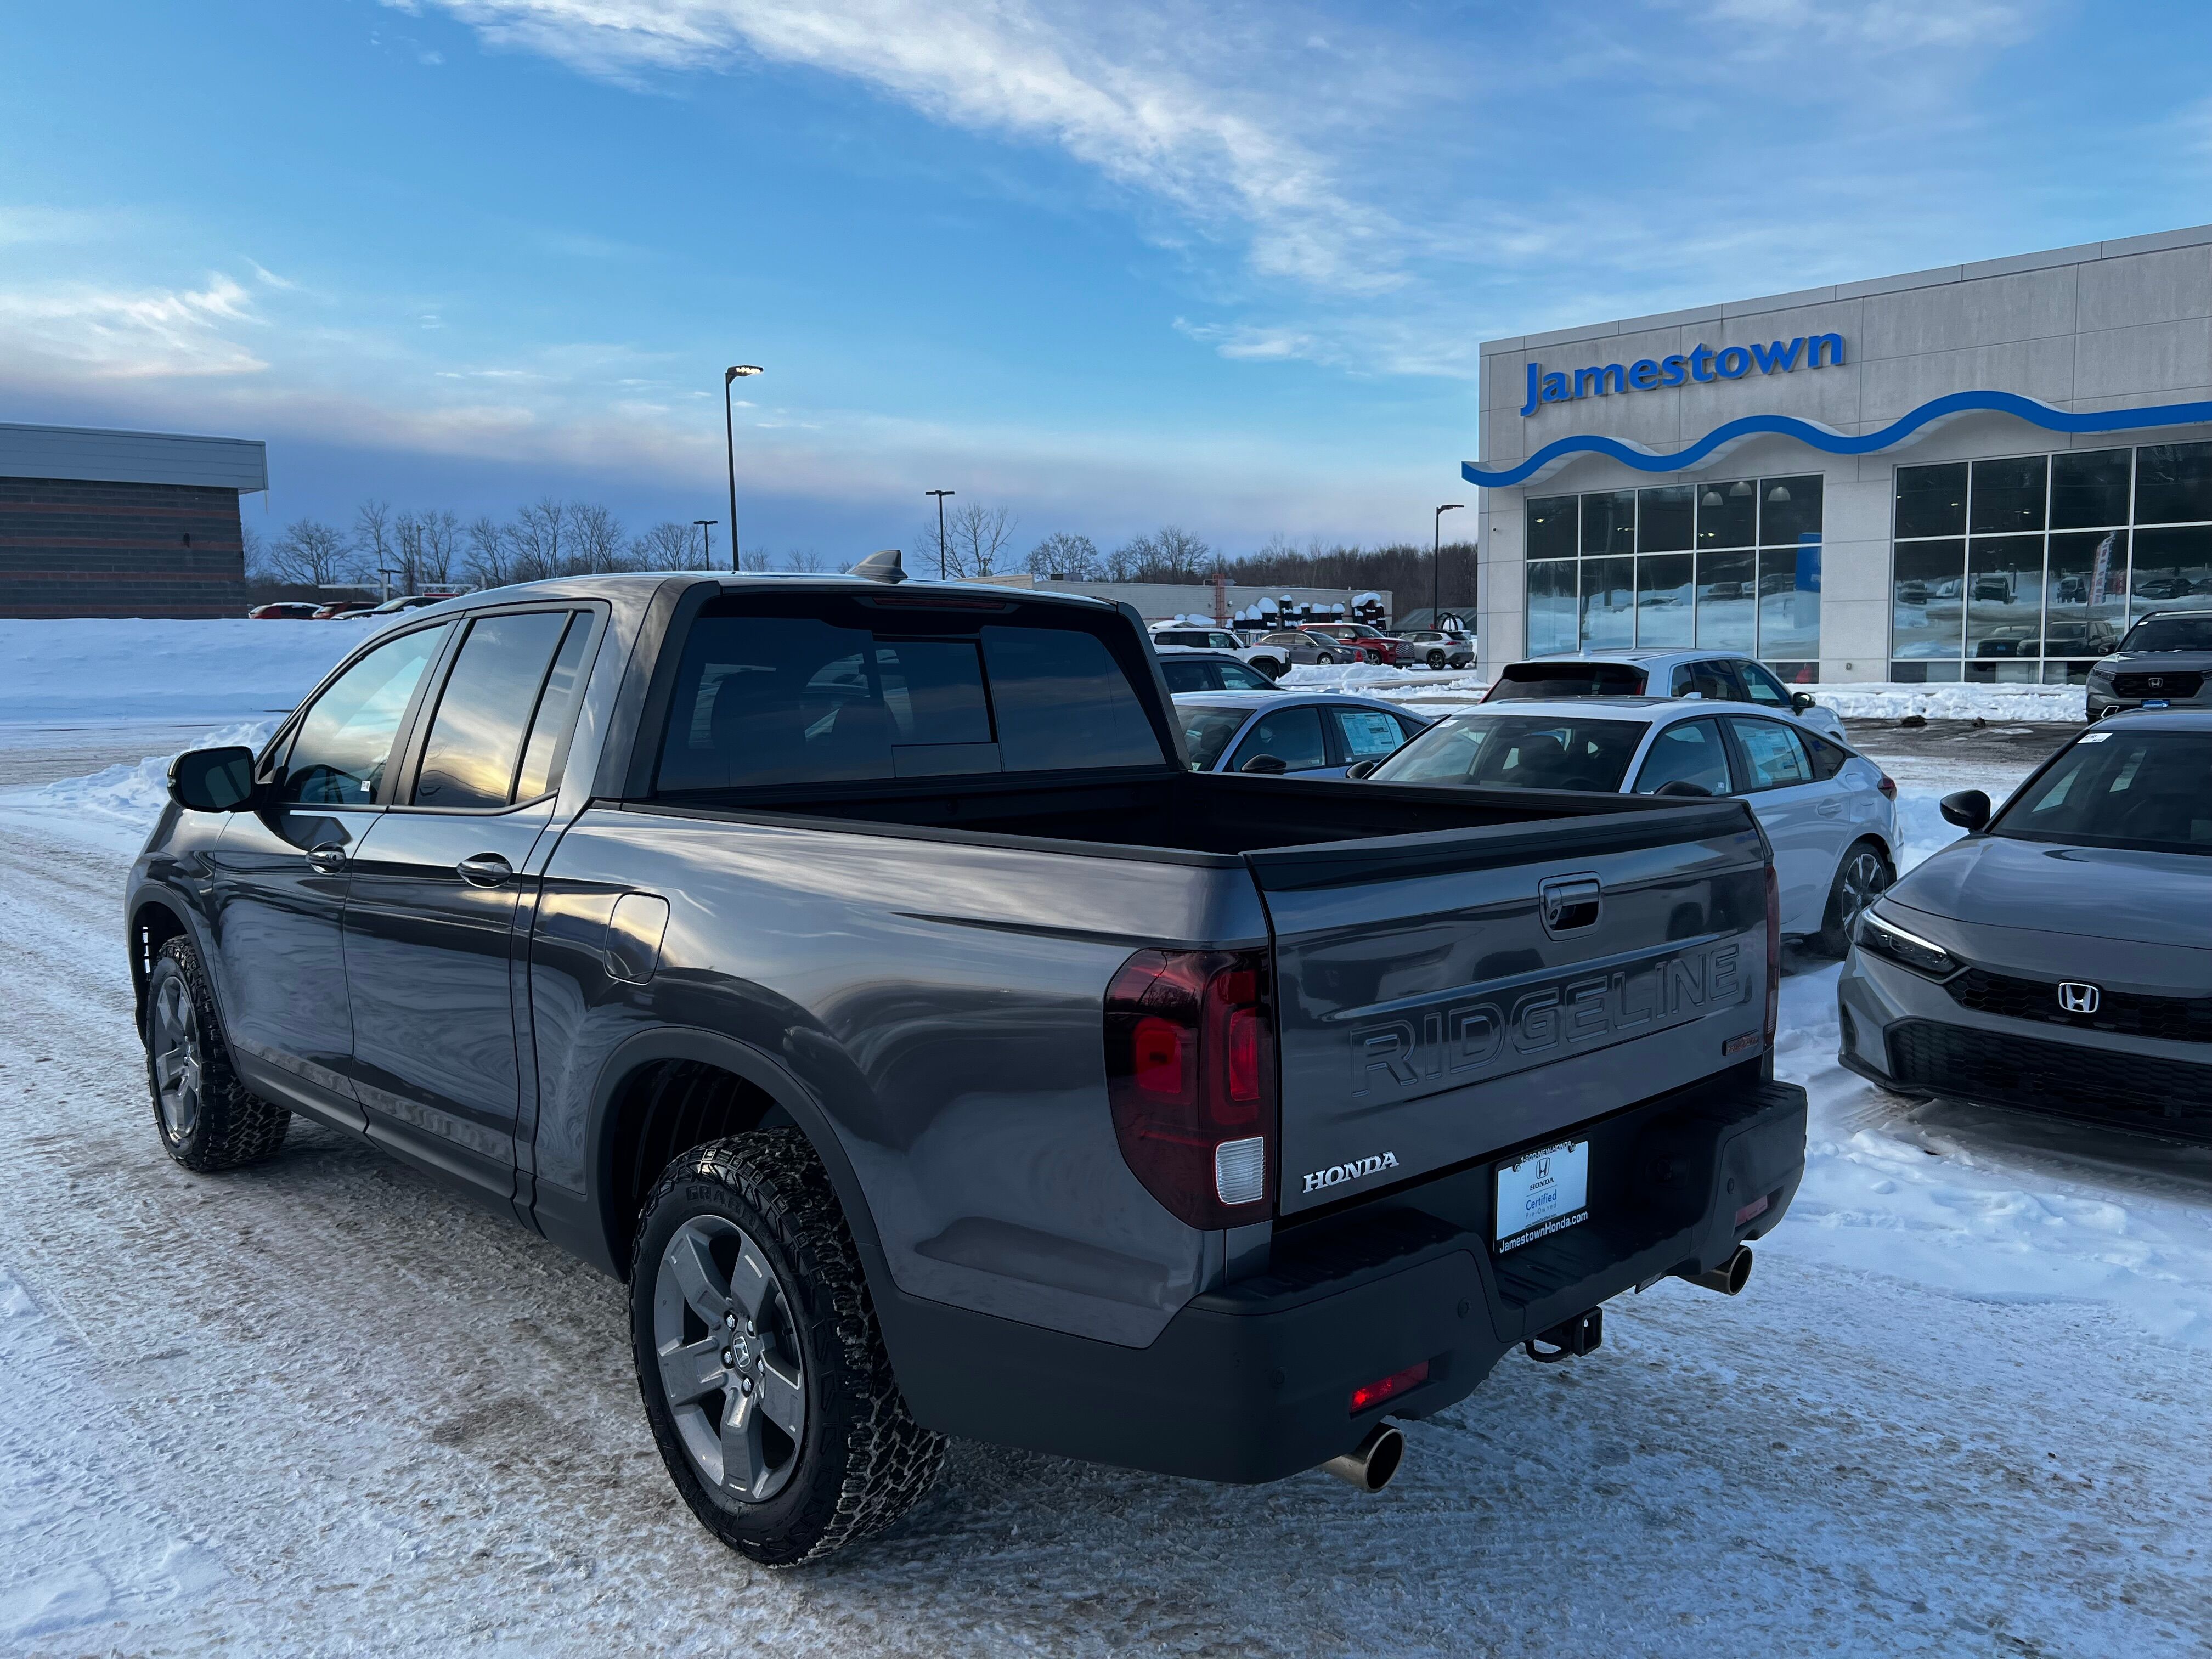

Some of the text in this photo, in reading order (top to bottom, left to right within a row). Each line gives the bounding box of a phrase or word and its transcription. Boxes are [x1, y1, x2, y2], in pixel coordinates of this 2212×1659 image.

[1520, 332, 1844, 417] Jamestown
[1350, 943, 1740, 1098] RIDGELINE
[1303, 1150, 1400, 1194] HONDA
[1529, 1177, 1555, 1191] HONDA
[1526, 1189, 1557, 1211] Certified
[1499, 1211, 1588, 1254] JamestownHonda.com
